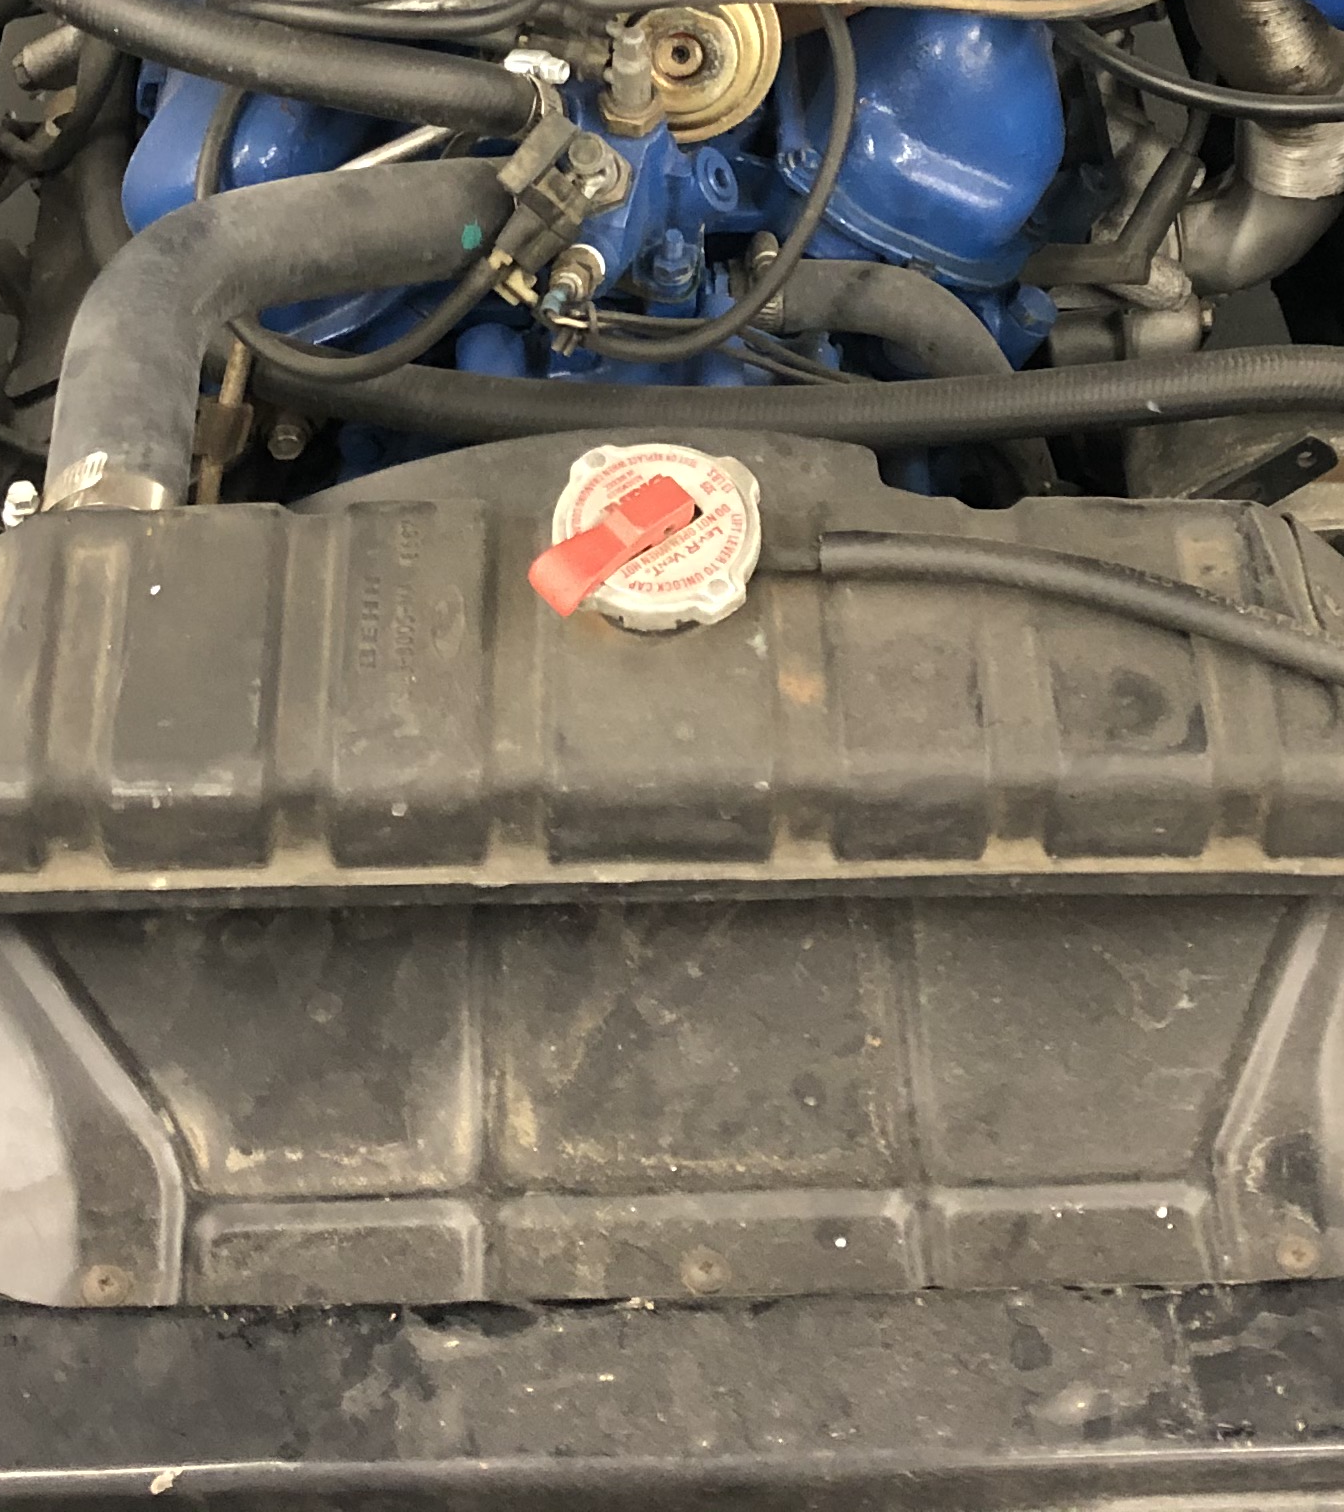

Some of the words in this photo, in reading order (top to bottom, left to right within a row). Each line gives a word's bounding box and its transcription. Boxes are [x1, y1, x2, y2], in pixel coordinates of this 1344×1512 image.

[714, 503, 732, 518] DO
[695, 513, 717, 531] NOT
[730, 513, 743, 533] LIFT
[715, 534, 740, 565] LEVER
[620, 561, 643, 579] HOT
[703, 562, 721, 577] TO
[628, 580, 654, 593] CAP
[656, 572, 705, 593] UNLOCK
